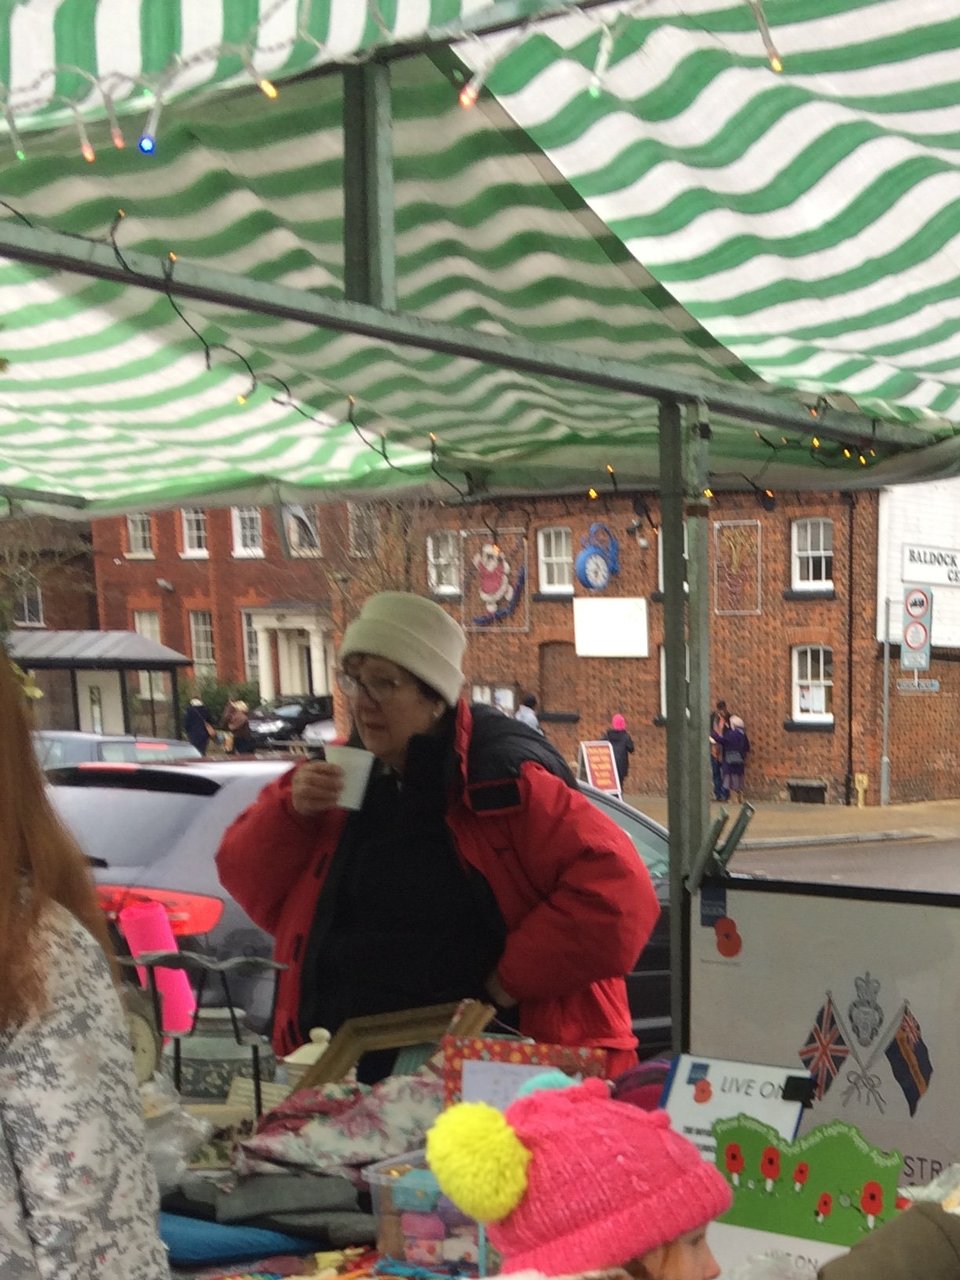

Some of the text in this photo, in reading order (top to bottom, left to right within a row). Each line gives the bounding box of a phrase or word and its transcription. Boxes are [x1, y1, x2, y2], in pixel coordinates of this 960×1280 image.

[908, 549, 958, 568] BALDOCK
[720, 1076, 756, 1097] LIVE
[902, 1155, 944, 1181] STR
